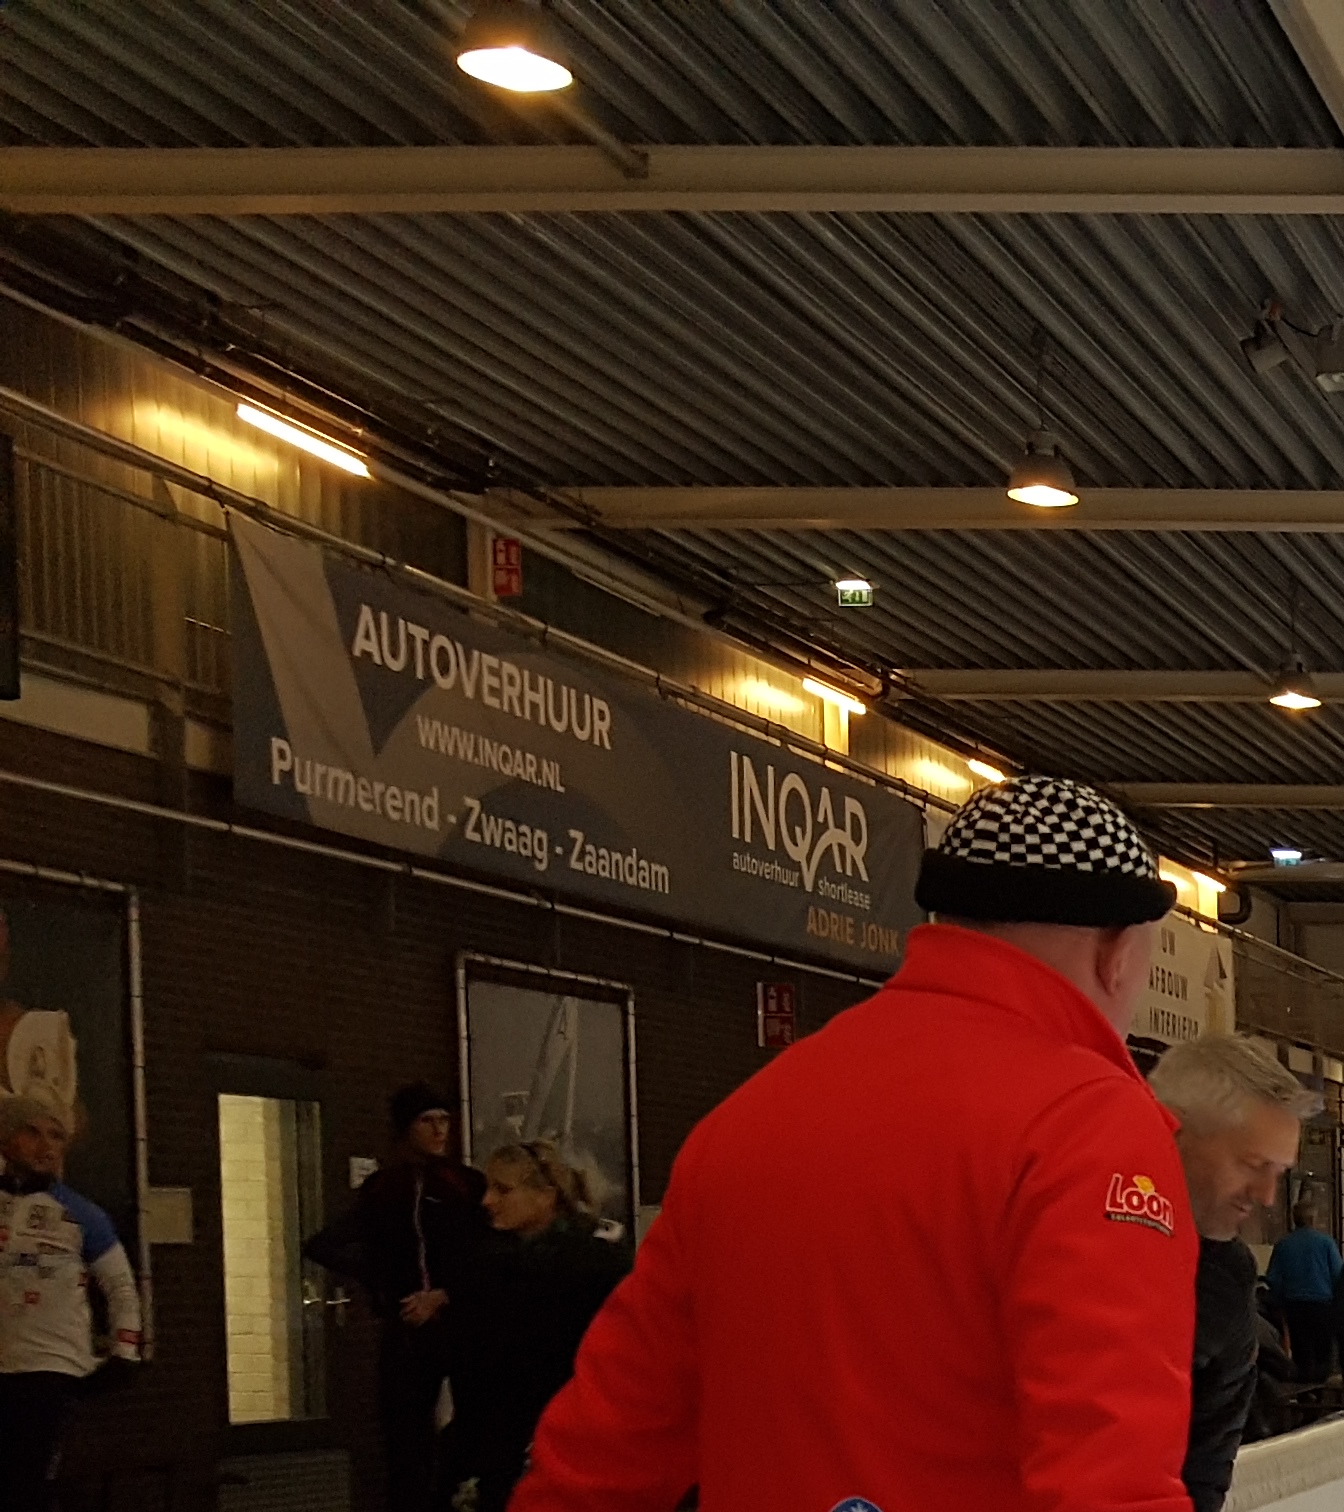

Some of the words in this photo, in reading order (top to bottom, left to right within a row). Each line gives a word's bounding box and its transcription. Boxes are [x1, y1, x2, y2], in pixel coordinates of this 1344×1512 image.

[351, 604, 612, 750] AUTOVERHUUR
[416, 715, 565, 793] WWW.INQAR.NL
[271, 737, 440, 831] Purmerend
[463, 796, 548, 871] Zwaag
[567, 828, 670, 894] Zaandam
[730, 750, 869, 892] INQAR
[732, 851, 800, 887] autoverhuur
[817, 876, 871, 911] shortlease
[806, 905, 855, 945] ADRIE
[860, 922, 899, 954] JONK
[1149, 965, 1188, 1001] AFBOUW
